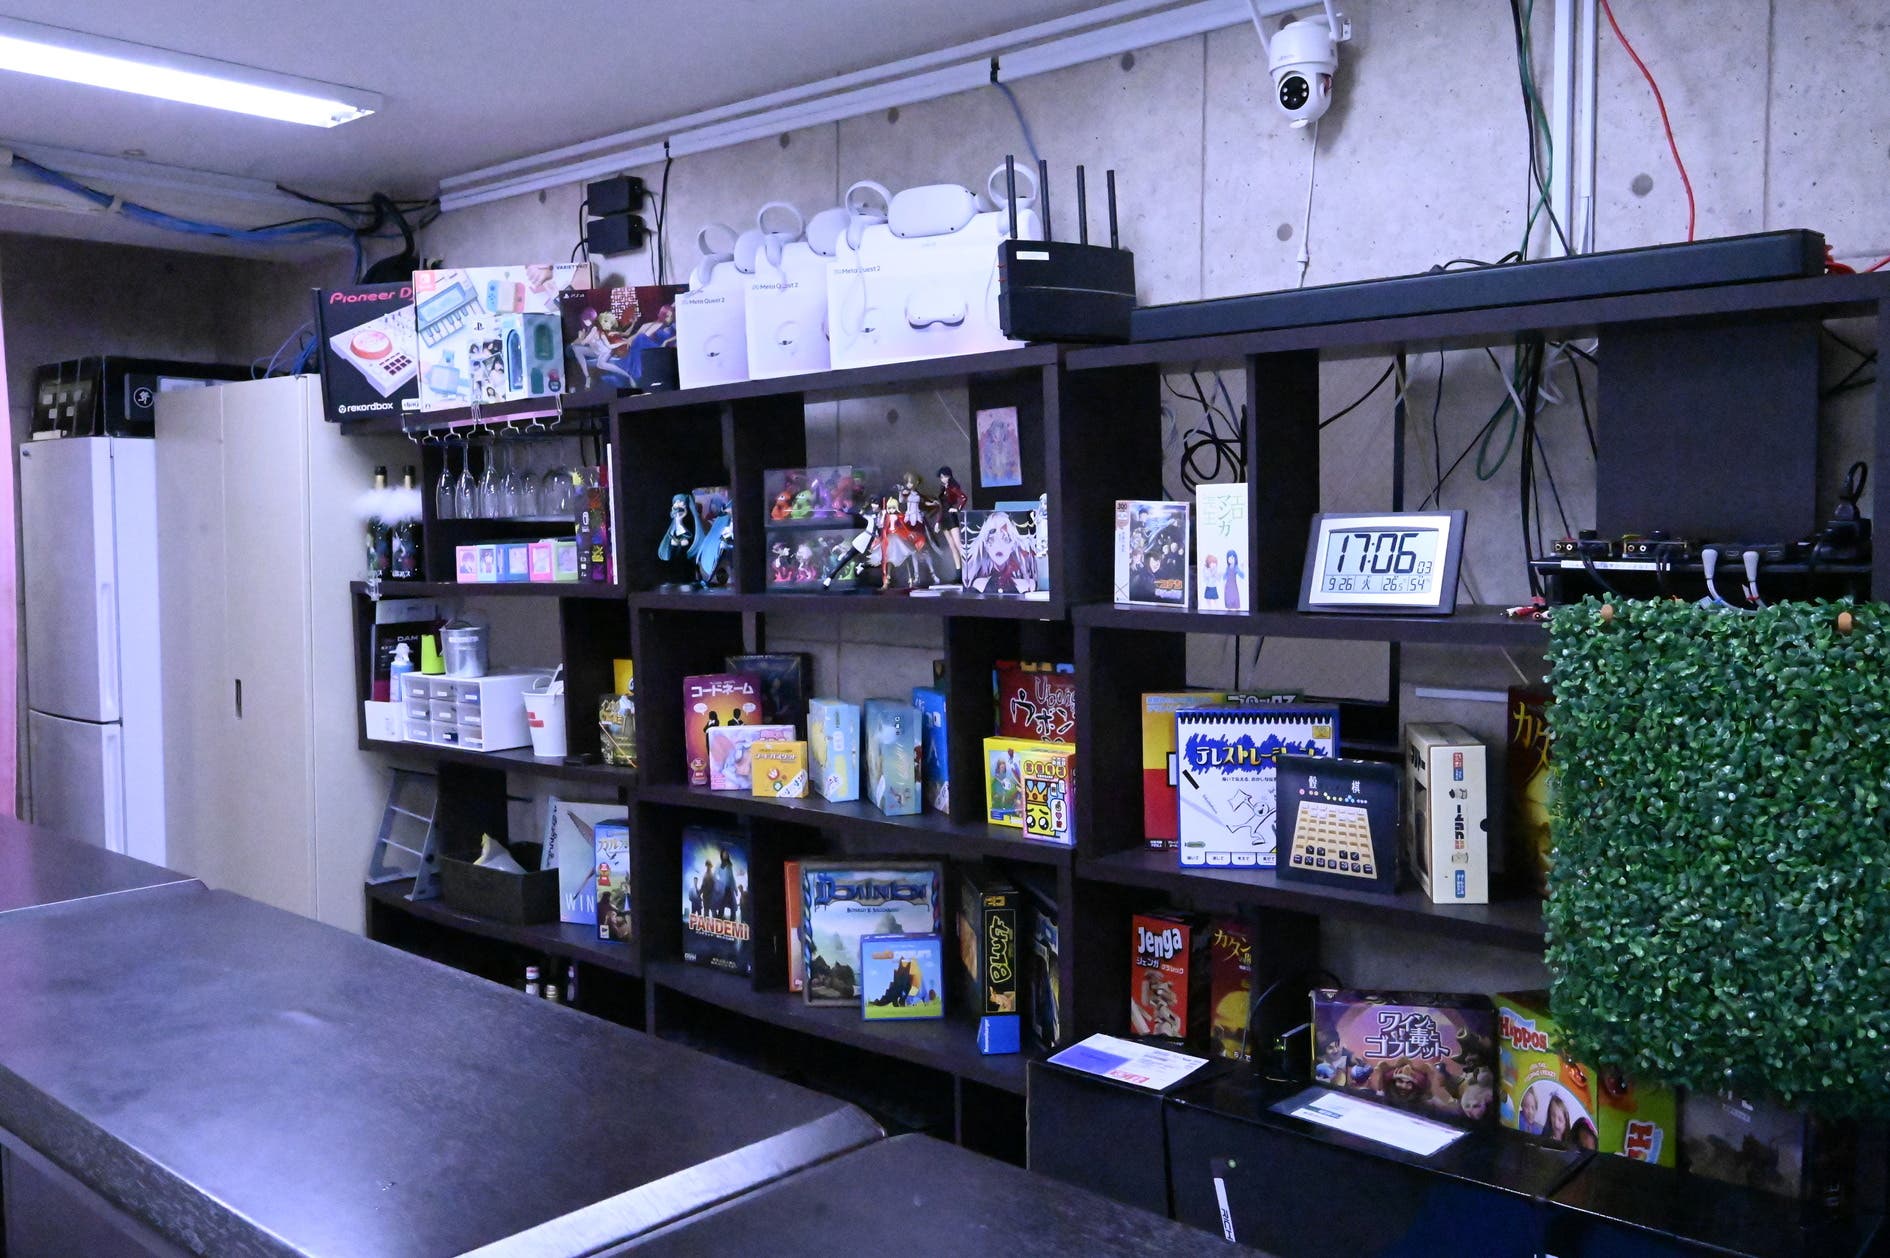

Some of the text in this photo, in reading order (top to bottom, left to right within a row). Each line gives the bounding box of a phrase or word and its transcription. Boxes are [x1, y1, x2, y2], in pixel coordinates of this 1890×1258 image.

[329, 287, 414, 304] Pioneer D
[347, 402, 394, 412] rekordbox
[1337, 533, 1433, 574] 17:06 03
[1328, 577, 1353, 591] 9 26
[691, 682, 754, 697] コードネーム
[565, 893, 595, 913] WIN
[688, 912, 750, 940] PANDEMI
[989, 915, 1012, 983] BLUFF
[1137, 926, 1183, 959] Jenga
[1136, 957, 1160, 968] ジェンガ
